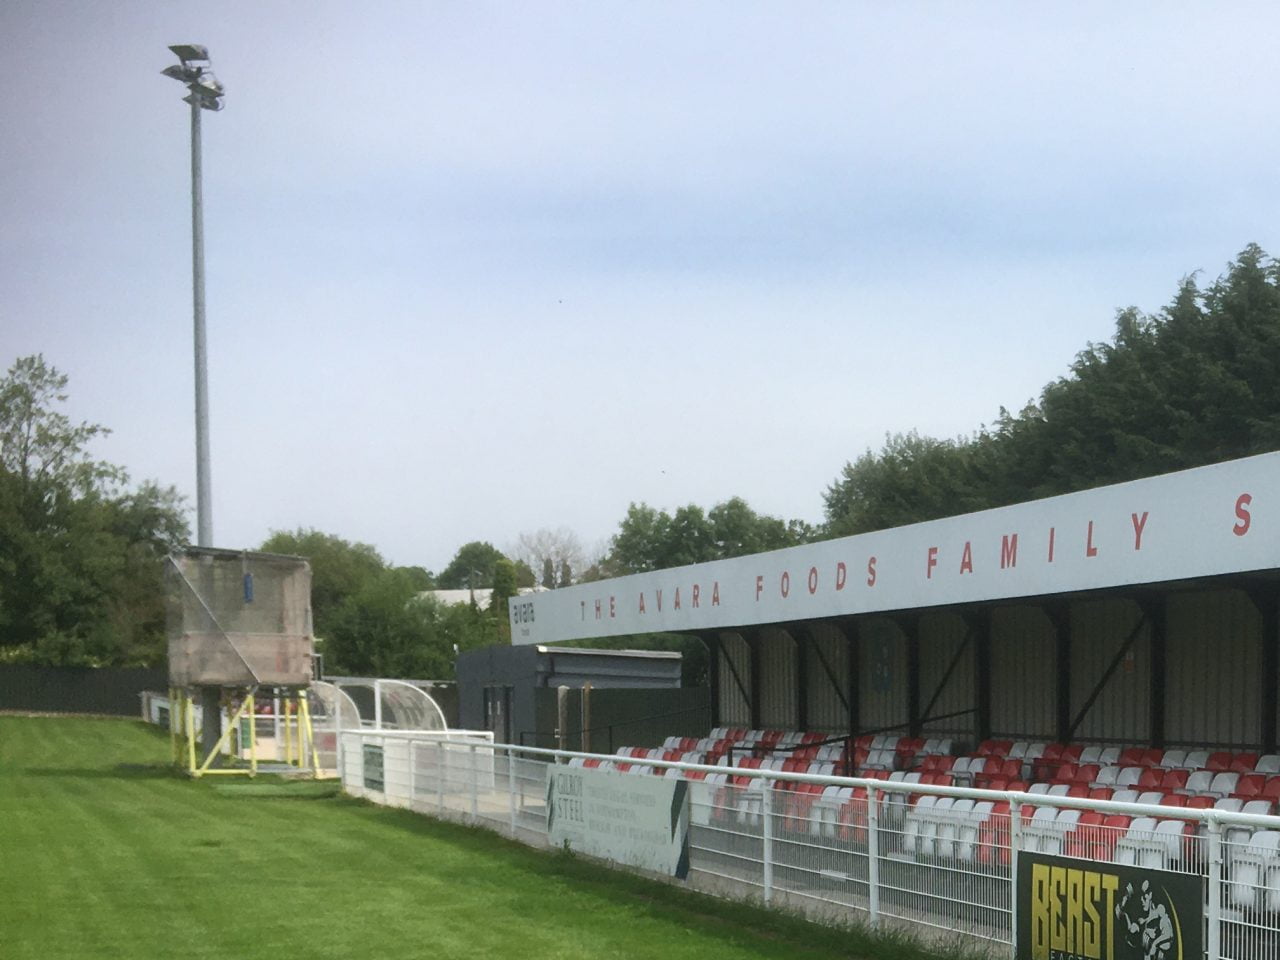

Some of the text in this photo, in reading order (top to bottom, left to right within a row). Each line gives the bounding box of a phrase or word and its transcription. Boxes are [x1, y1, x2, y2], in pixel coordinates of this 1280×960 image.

[581, 596, 616, 622] THE
[639, 582, 721, 615] AVARA
[755, 556, 878, 602] FOODS
[927, 512, 1149, 579] FAMILY
[557, 798, 585, 822] STEEL
